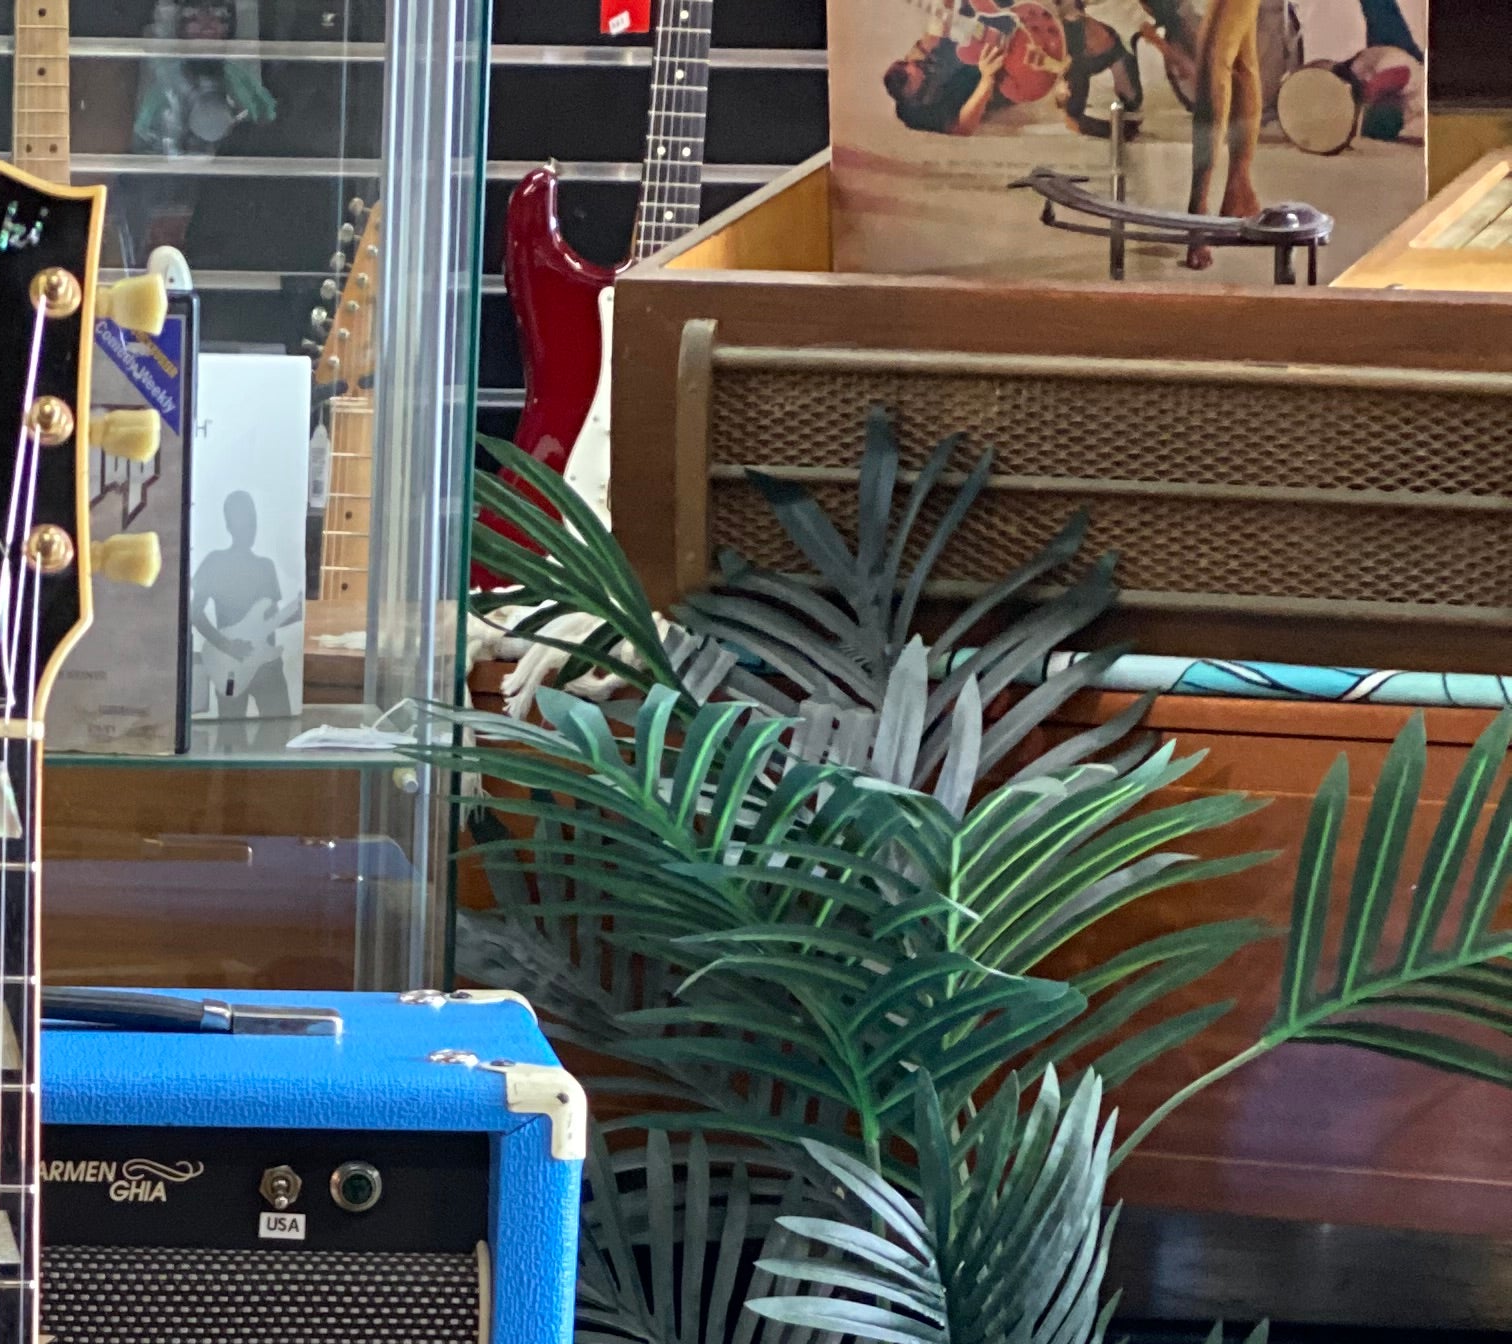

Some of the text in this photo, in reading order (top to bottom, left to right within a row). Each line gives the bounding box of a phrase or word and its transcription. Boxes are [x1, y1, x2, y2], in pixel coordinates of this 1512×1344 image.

[138, 366, 177, 414] Weekly
[39, 1160, 117, 1182] ARMEN
[109, 1180, 168, 1202] GHIA
[266, 1216, 300, 1233] USA
